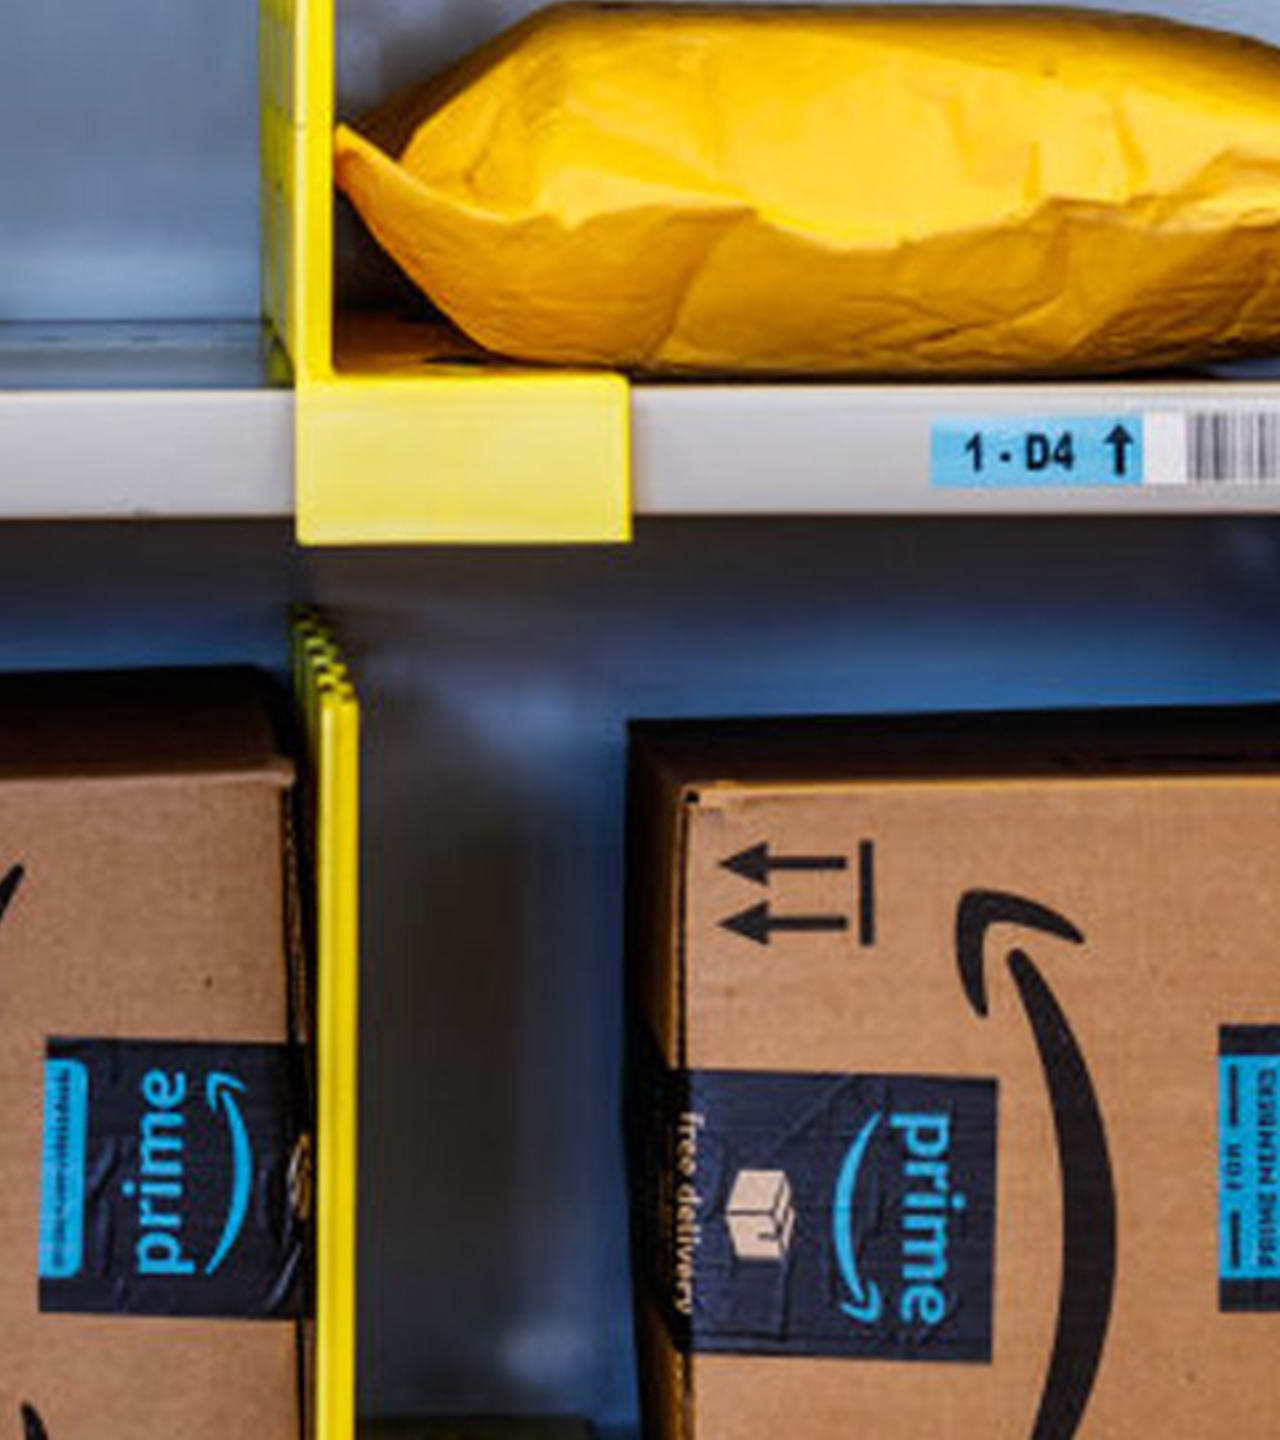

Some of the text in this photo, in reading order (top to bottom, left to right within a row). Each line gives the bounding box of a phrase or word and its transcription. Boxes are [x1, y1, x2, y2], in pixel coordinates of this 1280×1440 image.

[121, 1068, 195, 1275] prime
[675, 1112, 705, 1314] free delivery
[890, 1111, 967, 1326] prime
